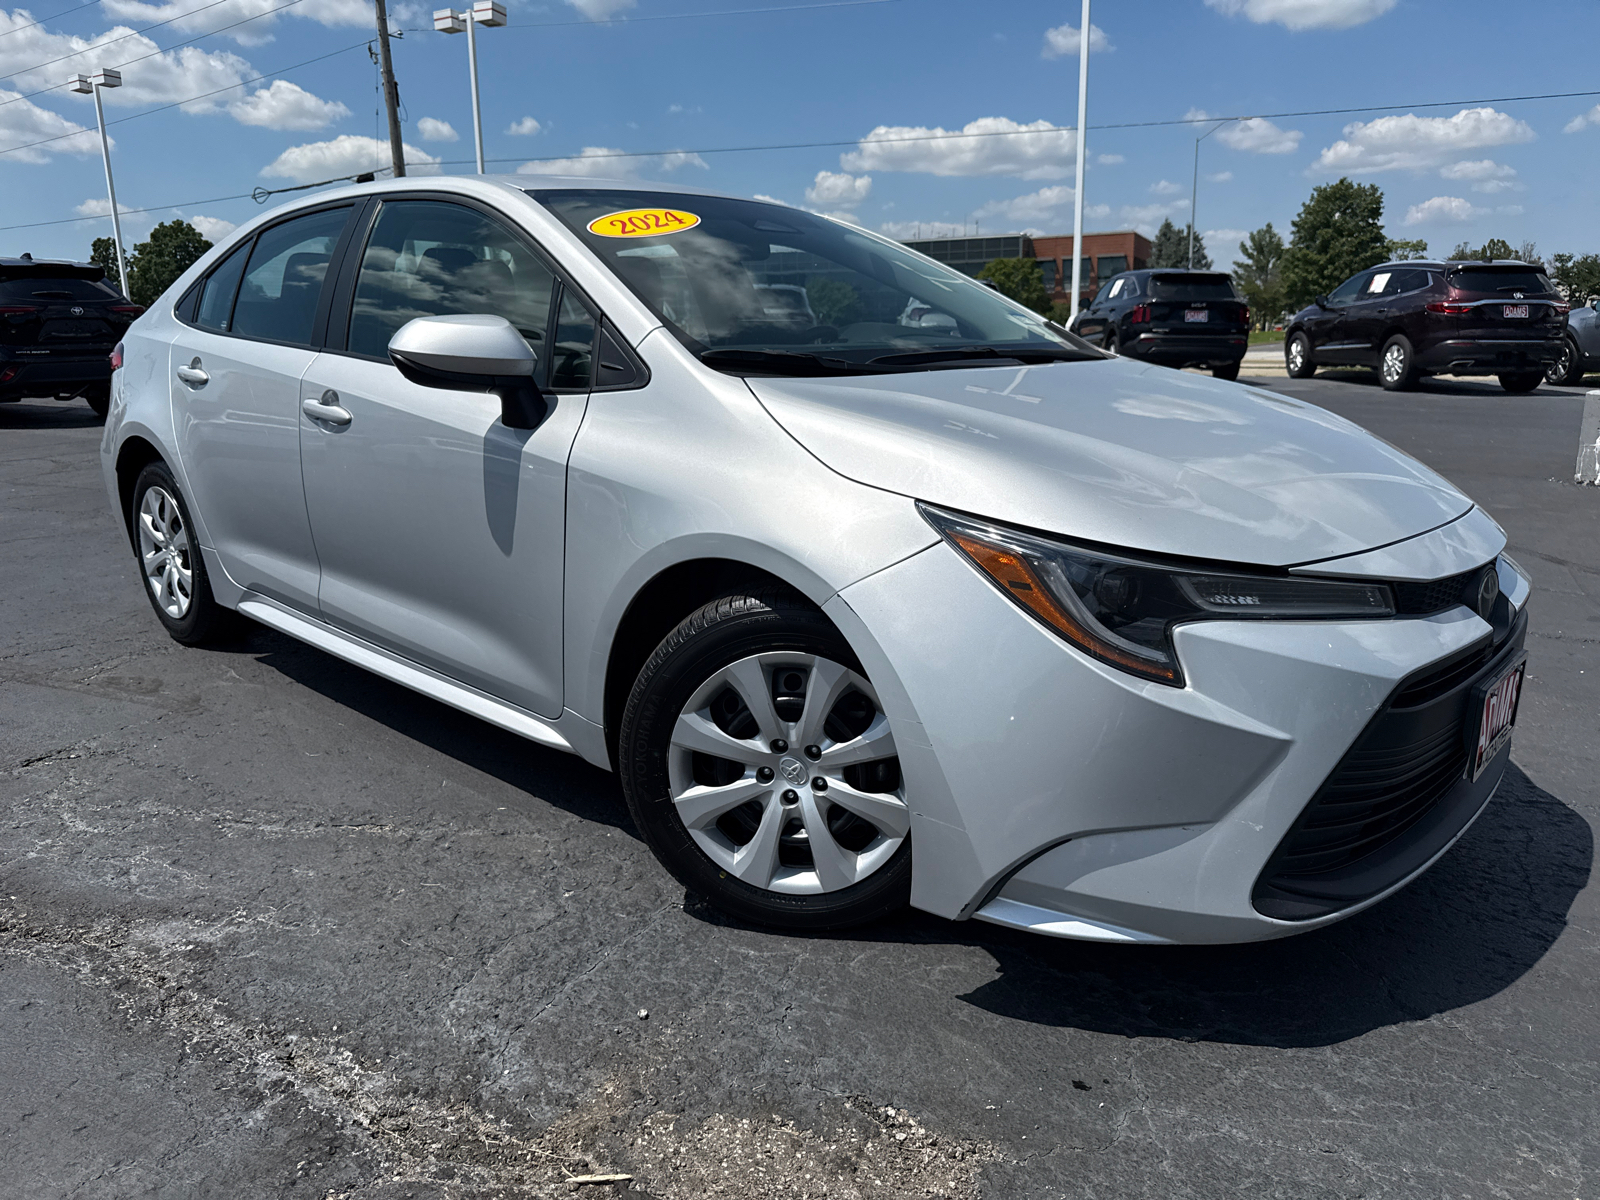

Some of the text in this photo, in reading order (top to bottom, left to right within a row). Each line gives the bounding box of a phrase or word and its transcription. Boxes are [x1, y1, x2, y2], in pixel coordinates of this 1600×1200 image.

[610, 211, 687, 235] 2024
[1186, 311, 1206, 320] ADAMS
[1505, 306, 1527, 316] ADAMS
[635, 693, 664, 782] YOKOHAMA
